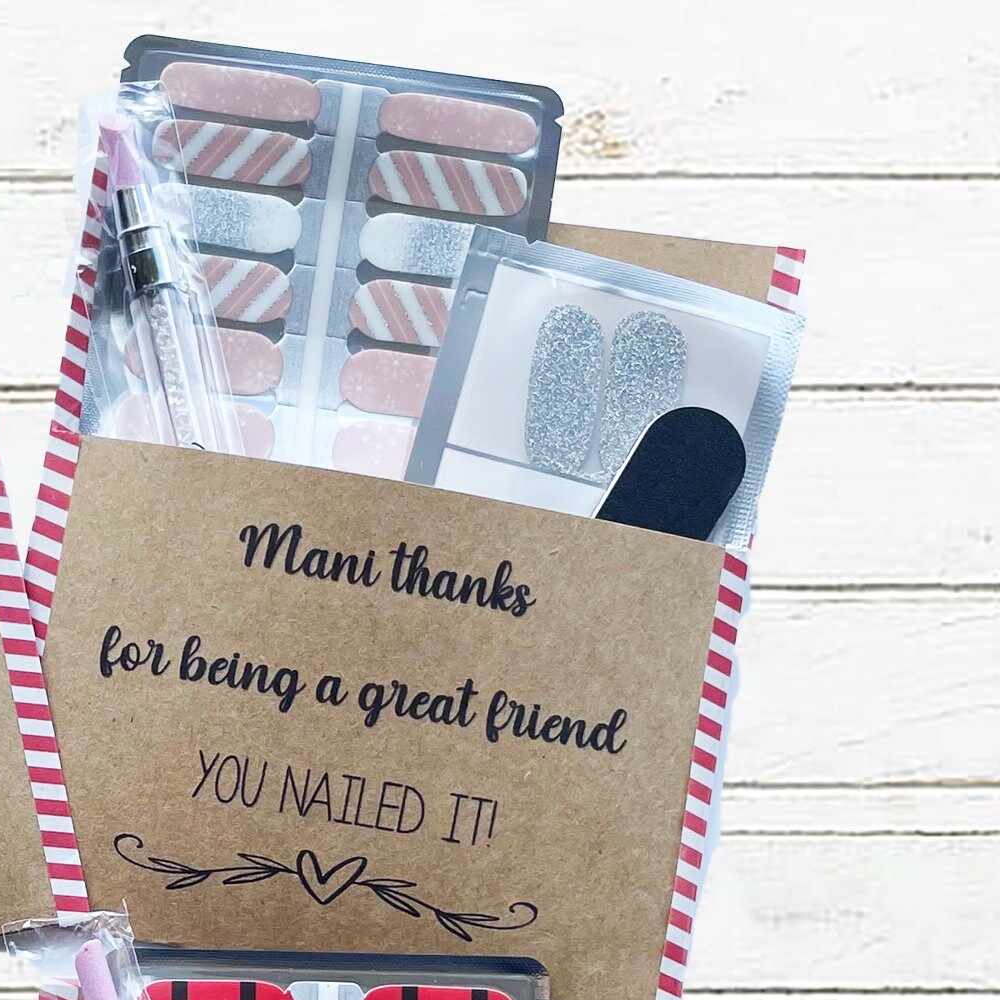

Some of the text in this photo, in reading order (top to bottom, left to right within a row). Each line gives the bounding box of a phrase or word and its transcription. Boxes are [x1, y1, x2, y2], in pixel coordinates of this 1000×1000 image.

[239, 523, 536, 617] Mani thanks
[100, 625, 628, 754] for being a great friend
[192, 749, 498, 848] YOU NAILED IT!
